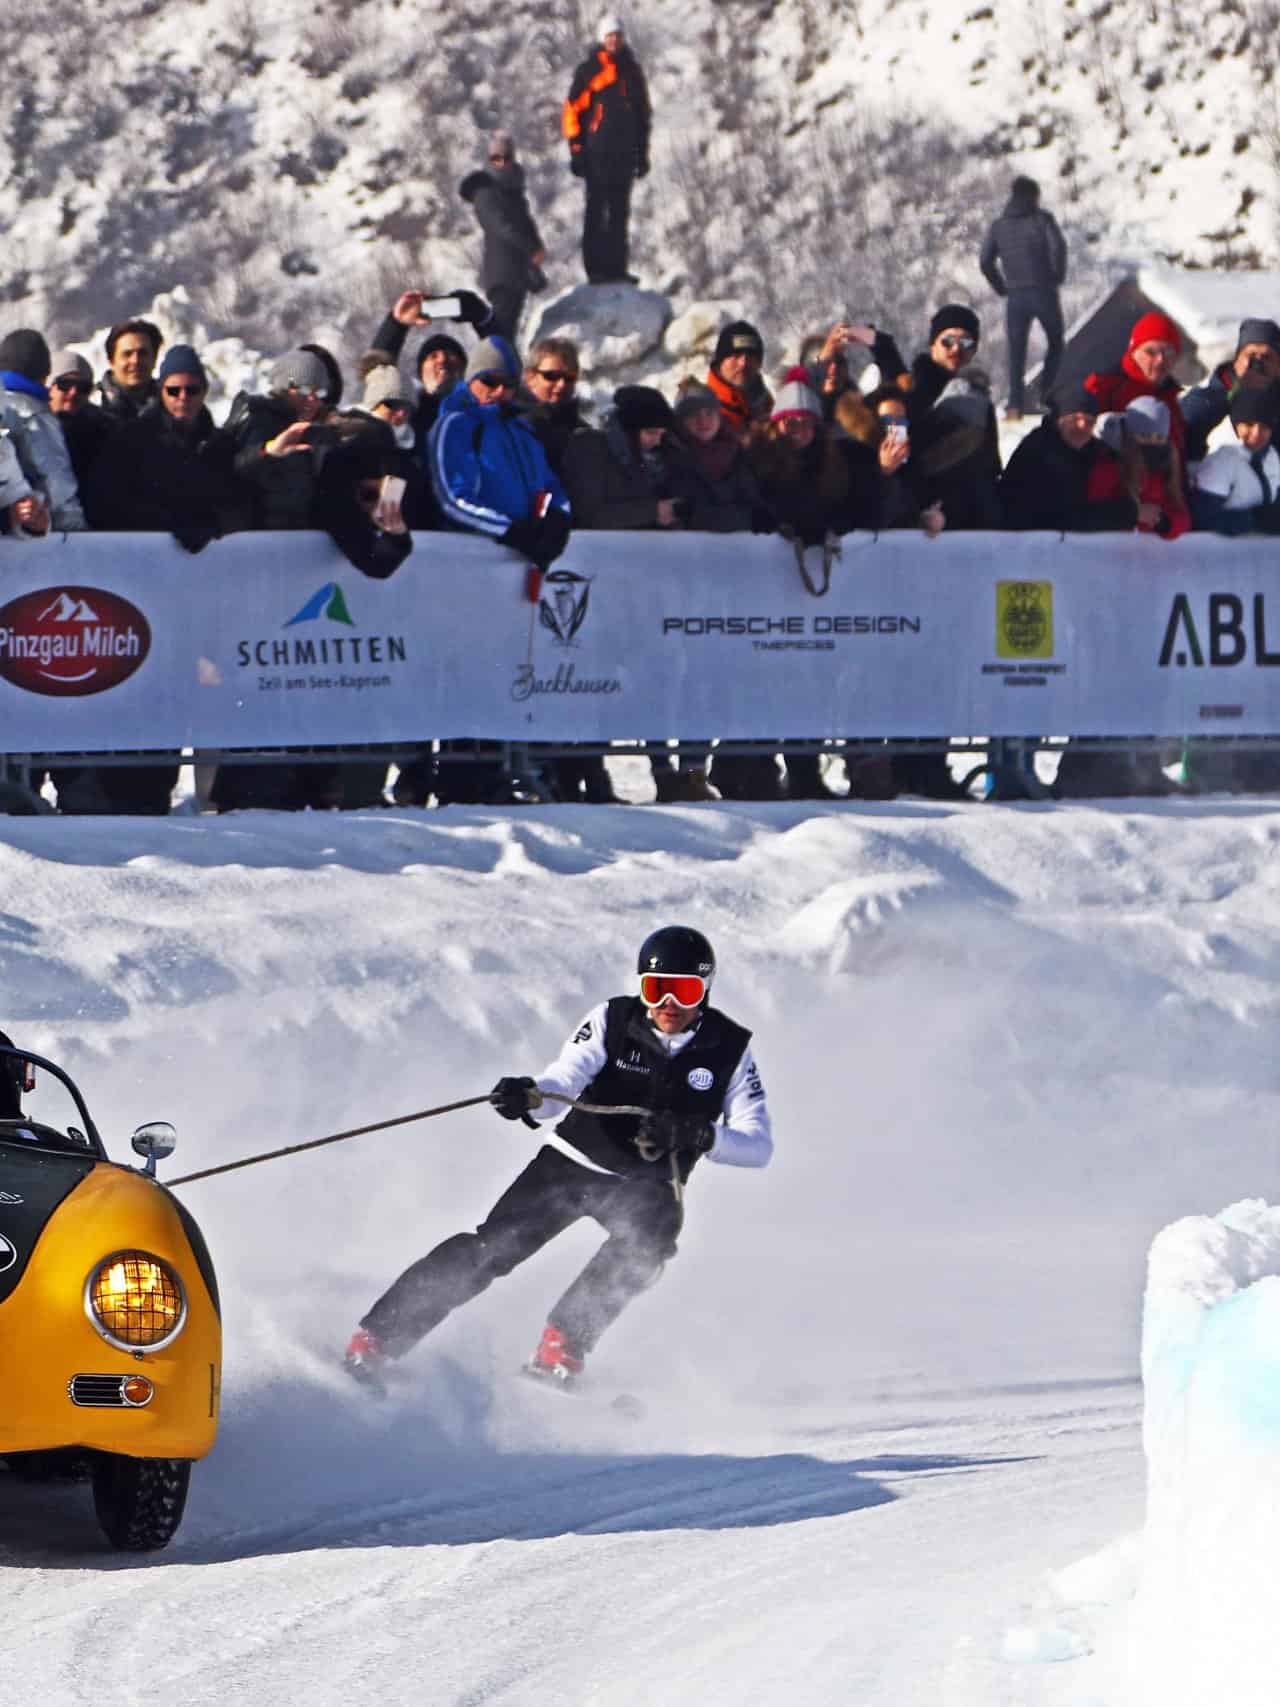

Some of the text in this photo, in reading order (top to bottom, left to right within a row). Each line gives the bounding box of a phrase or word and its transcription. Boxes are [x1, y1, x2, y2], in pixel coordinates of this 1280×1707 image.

[82, 625, 140, 658] Milch
[663, 616, 921, 636] PORSCHE DESIGN
[237, 636, 408, 667] SCHMITTEN
